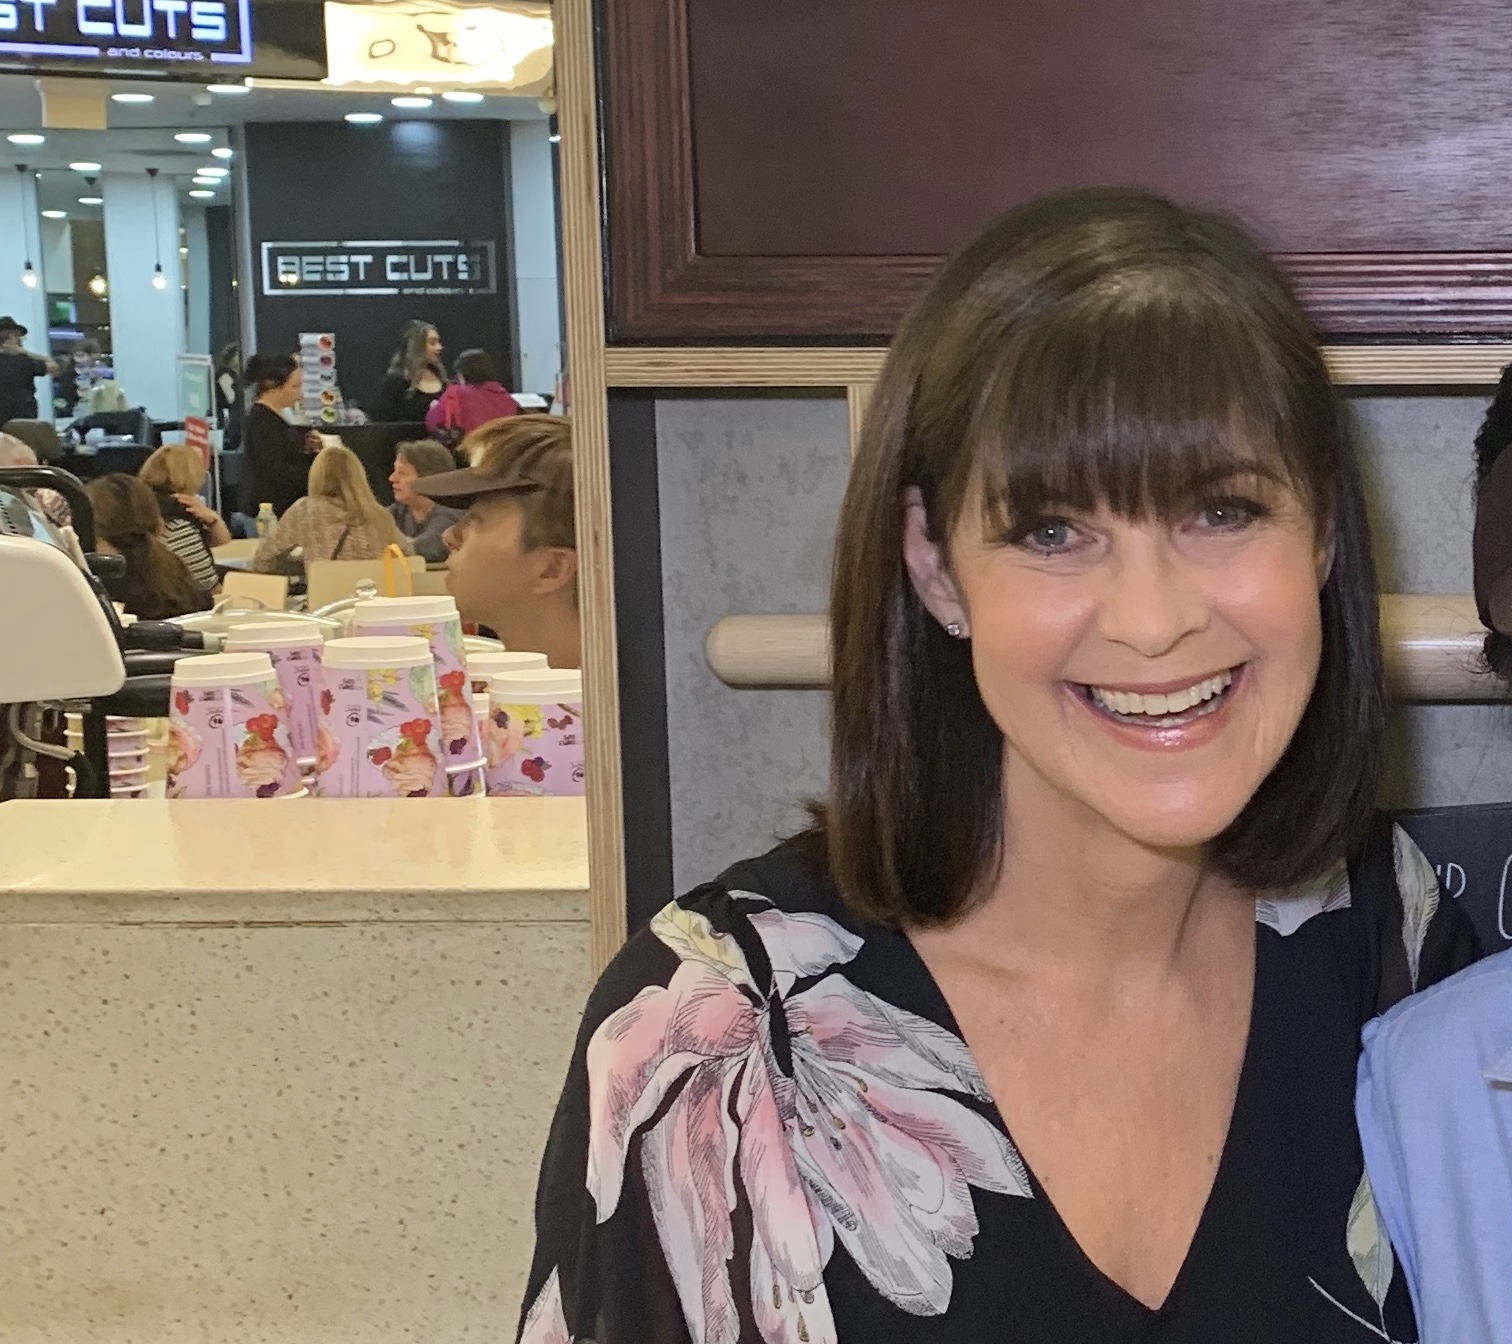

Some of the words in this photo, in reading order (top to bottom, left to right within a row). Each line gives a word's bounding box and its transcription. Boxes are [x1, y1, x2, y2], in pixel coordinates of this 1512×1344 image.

[106, 47, 140, 59] and
[143, 48, 204, 61] colours
[277, 254, 373, 283] BEST
[385, 254, 481, 281] CUTS
